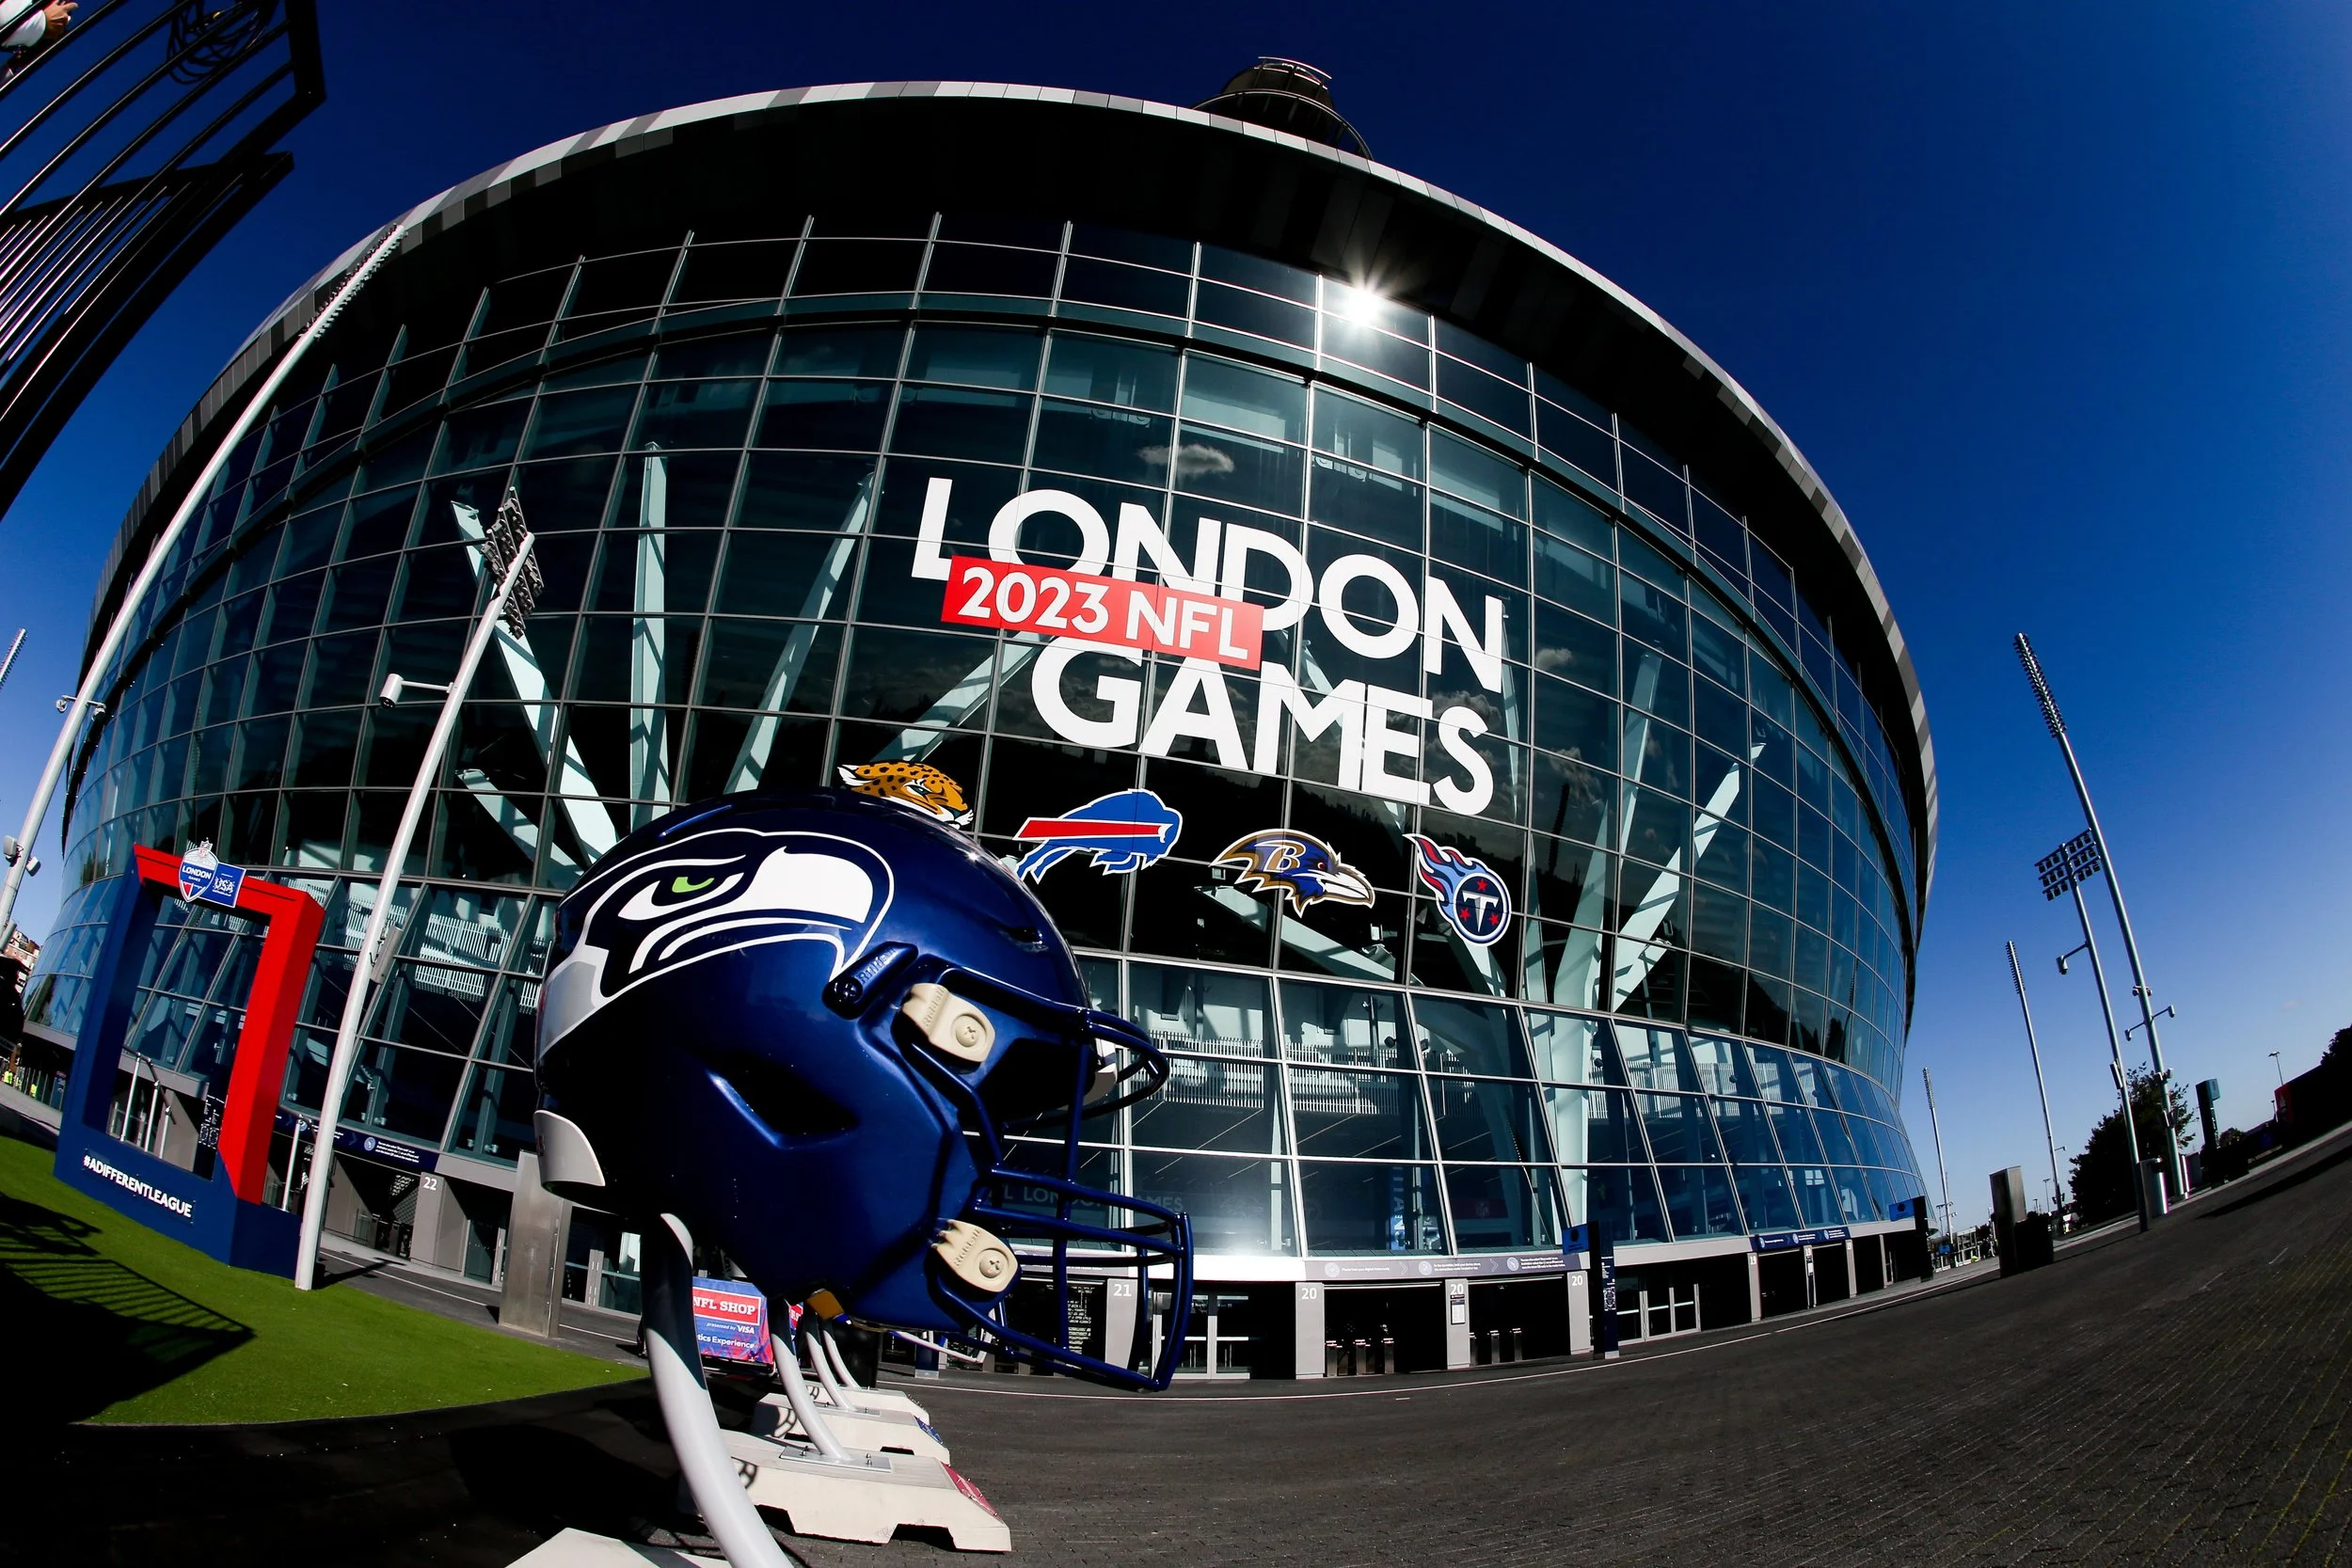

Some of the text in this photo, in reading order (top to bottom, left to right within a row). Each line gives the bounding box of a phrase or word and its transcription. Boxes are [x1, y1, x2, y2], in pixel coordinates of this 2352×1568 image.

[911, 477, 1503, 693] LONDON
[958, 566, 1248, 659] 2023 NFL
[1031, 636, 1494, 816] GAMES
[182, 865, 213, 879] LONDON
[1462, 890, 1499, 932] T
[83, 1155, 193, 1218] #ADIFFERENTLEAGUE
[422, 1176, 437, 1191] 22
[1571, 1275, 1583, 1287] 20
[1113, 1283, 1132, 1297] 21
[1301, 1287, 1317, 1300] 20
[1450, 1283, 1464, 1295] 20
[693, 1296, 755, 1316] NFL SHOP
[737, 1324, 755, 1335] VISA
[697, 1333, 755, 1349] tics Experience
